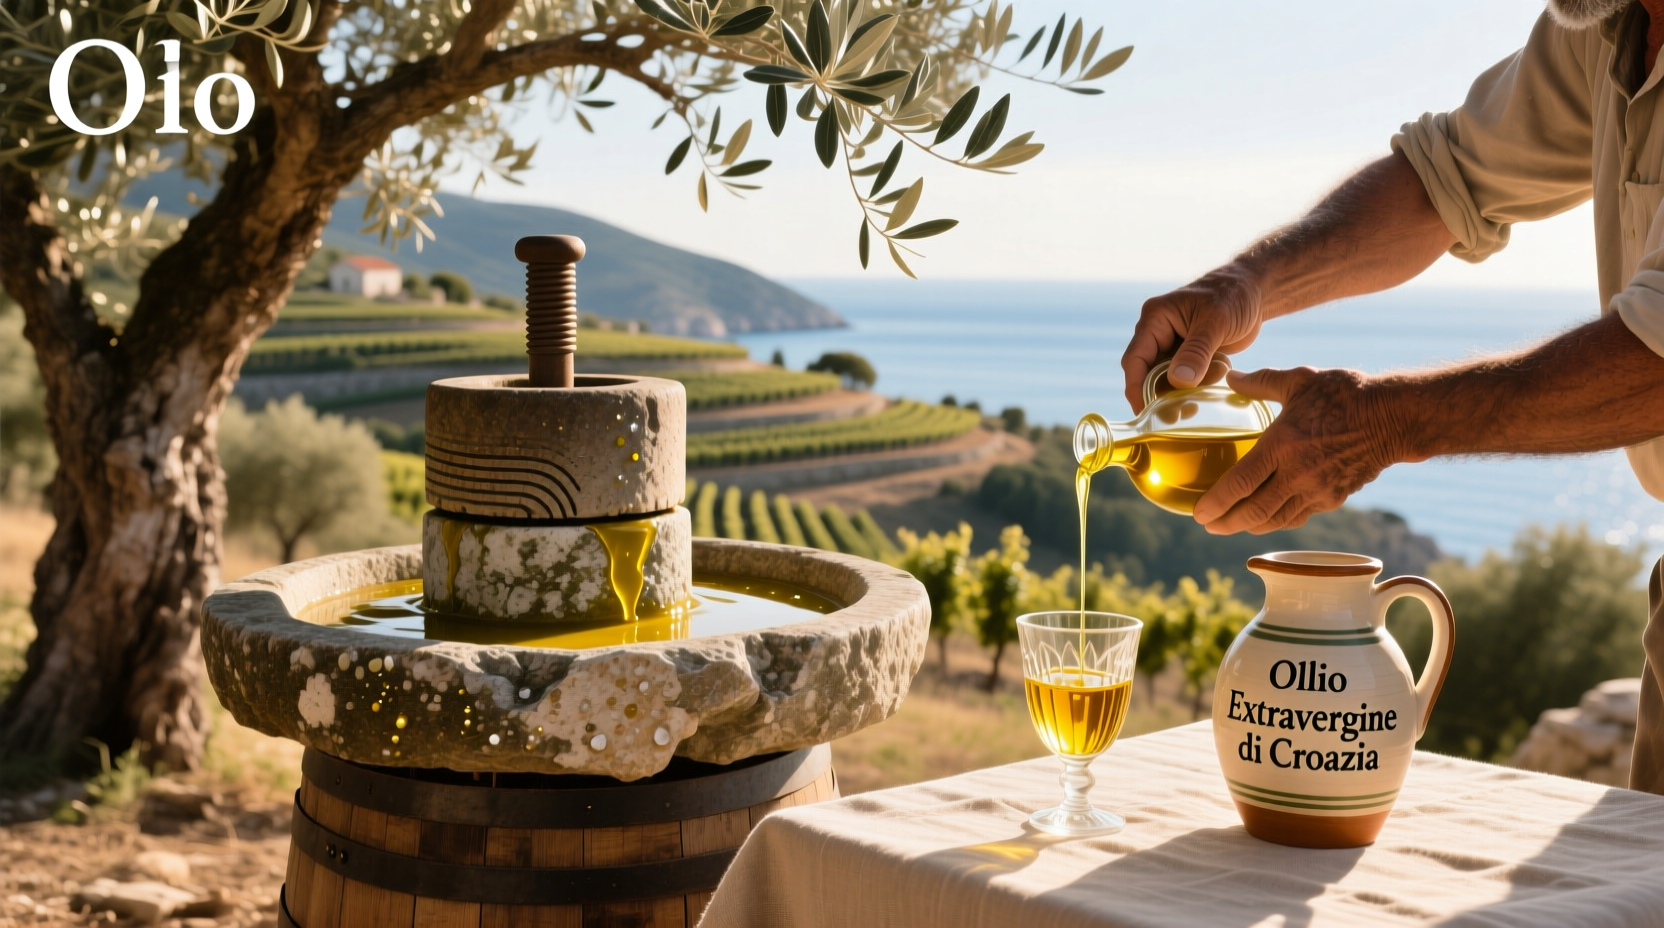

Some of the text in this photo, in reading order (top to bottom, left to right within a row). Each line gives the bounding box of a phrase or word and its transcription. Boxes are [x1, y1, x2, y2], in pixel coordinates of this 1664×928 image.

[1269, 659, 1347, 692] Ollio
[1227, 689, 1397, 742] Extravergine
[1238, 732, 1379, 771] di Croazia
